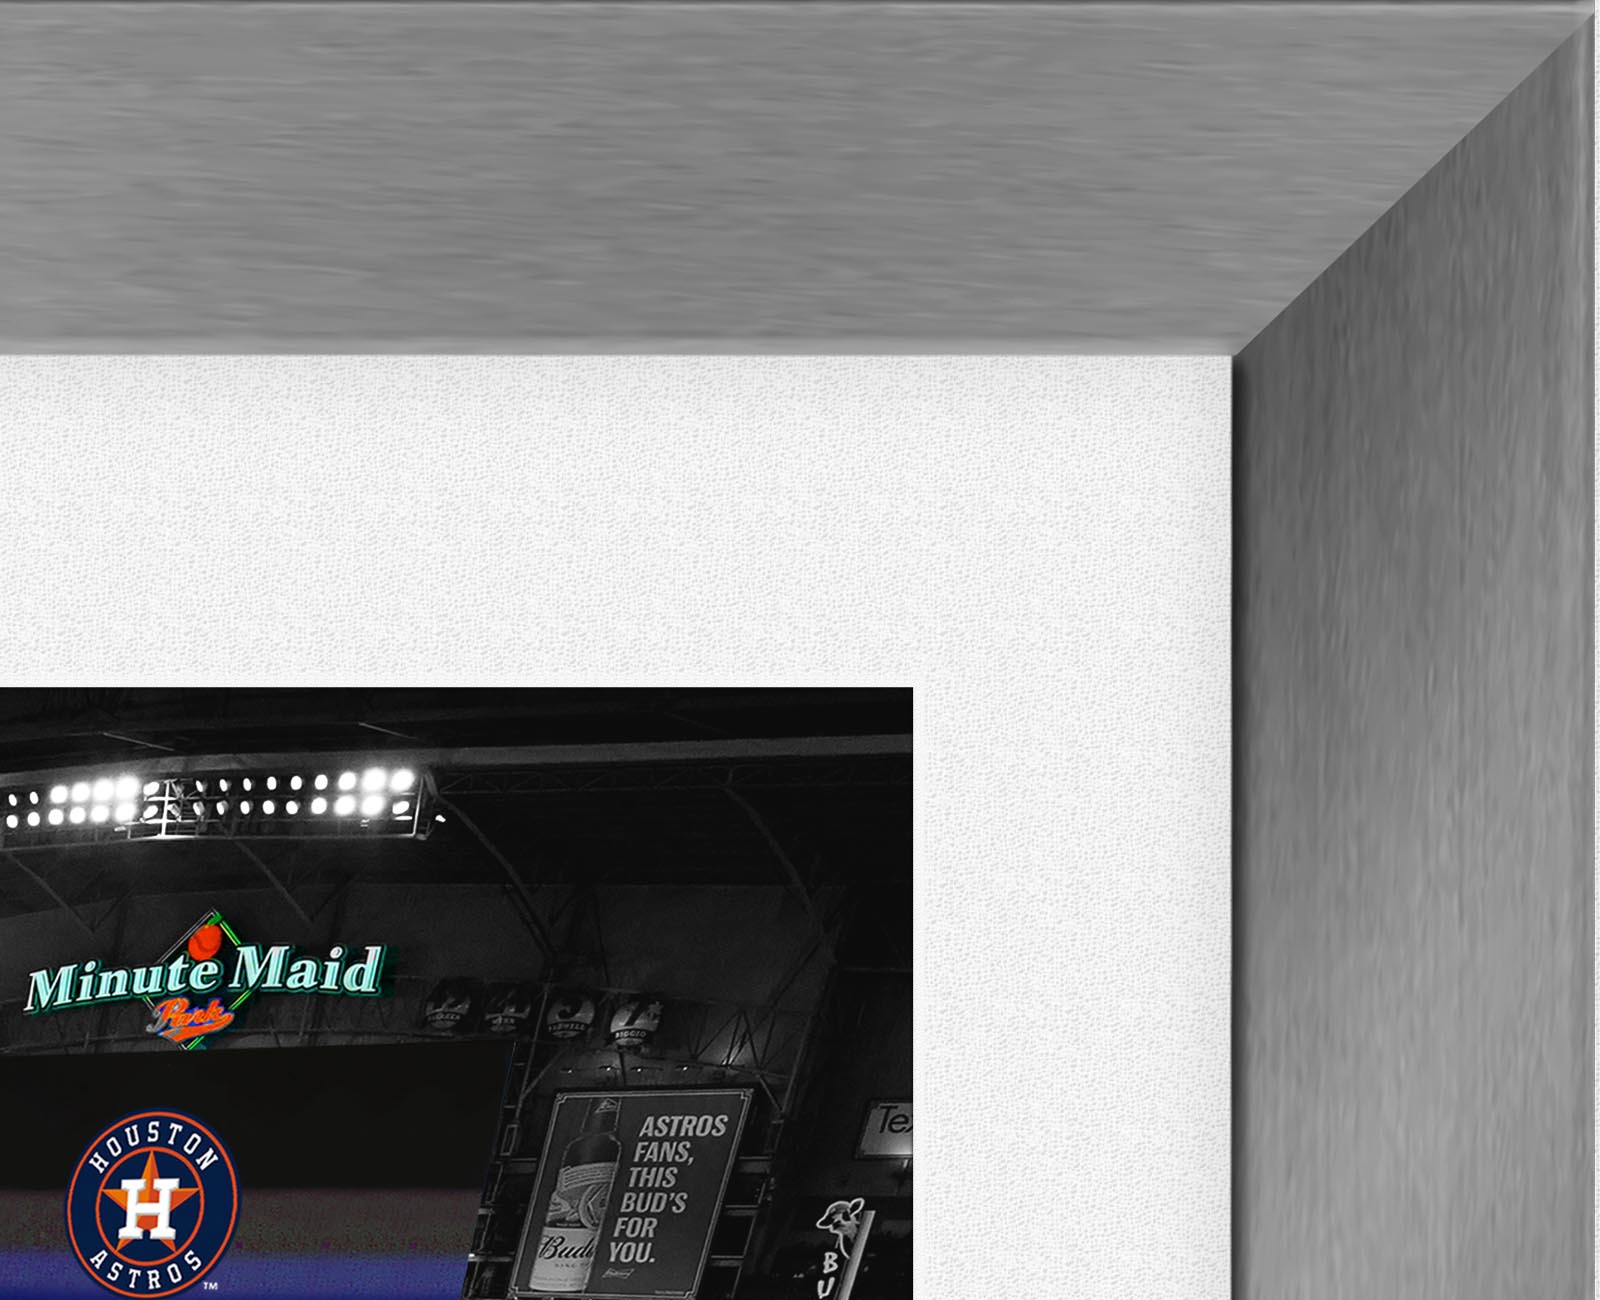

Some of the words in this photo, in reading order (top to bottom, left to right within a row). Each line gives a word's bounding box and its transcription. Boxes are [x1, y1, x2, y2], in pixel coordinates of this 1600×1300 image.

[24, 950, 217, 1012] Minute
[229, 944, 385, 996] Maid
[150, 998, 234, 1040] Park
[639, 1115, 729, 1137] ASTROS
[89, 1121, 219, 1175] HOUSTON
[633, 1141, 694, 1166] FANS,
[628, 1167, 678, 1188] THIS
[118, 1178, 180, 1240] H
[620, 1192, 688, 1214] BUD'S
[613, 1217, 658, 1238] FOR
[609, 1242, 655, 1263] YOU.
[90, 1249, 202, 1290] ASTROS
